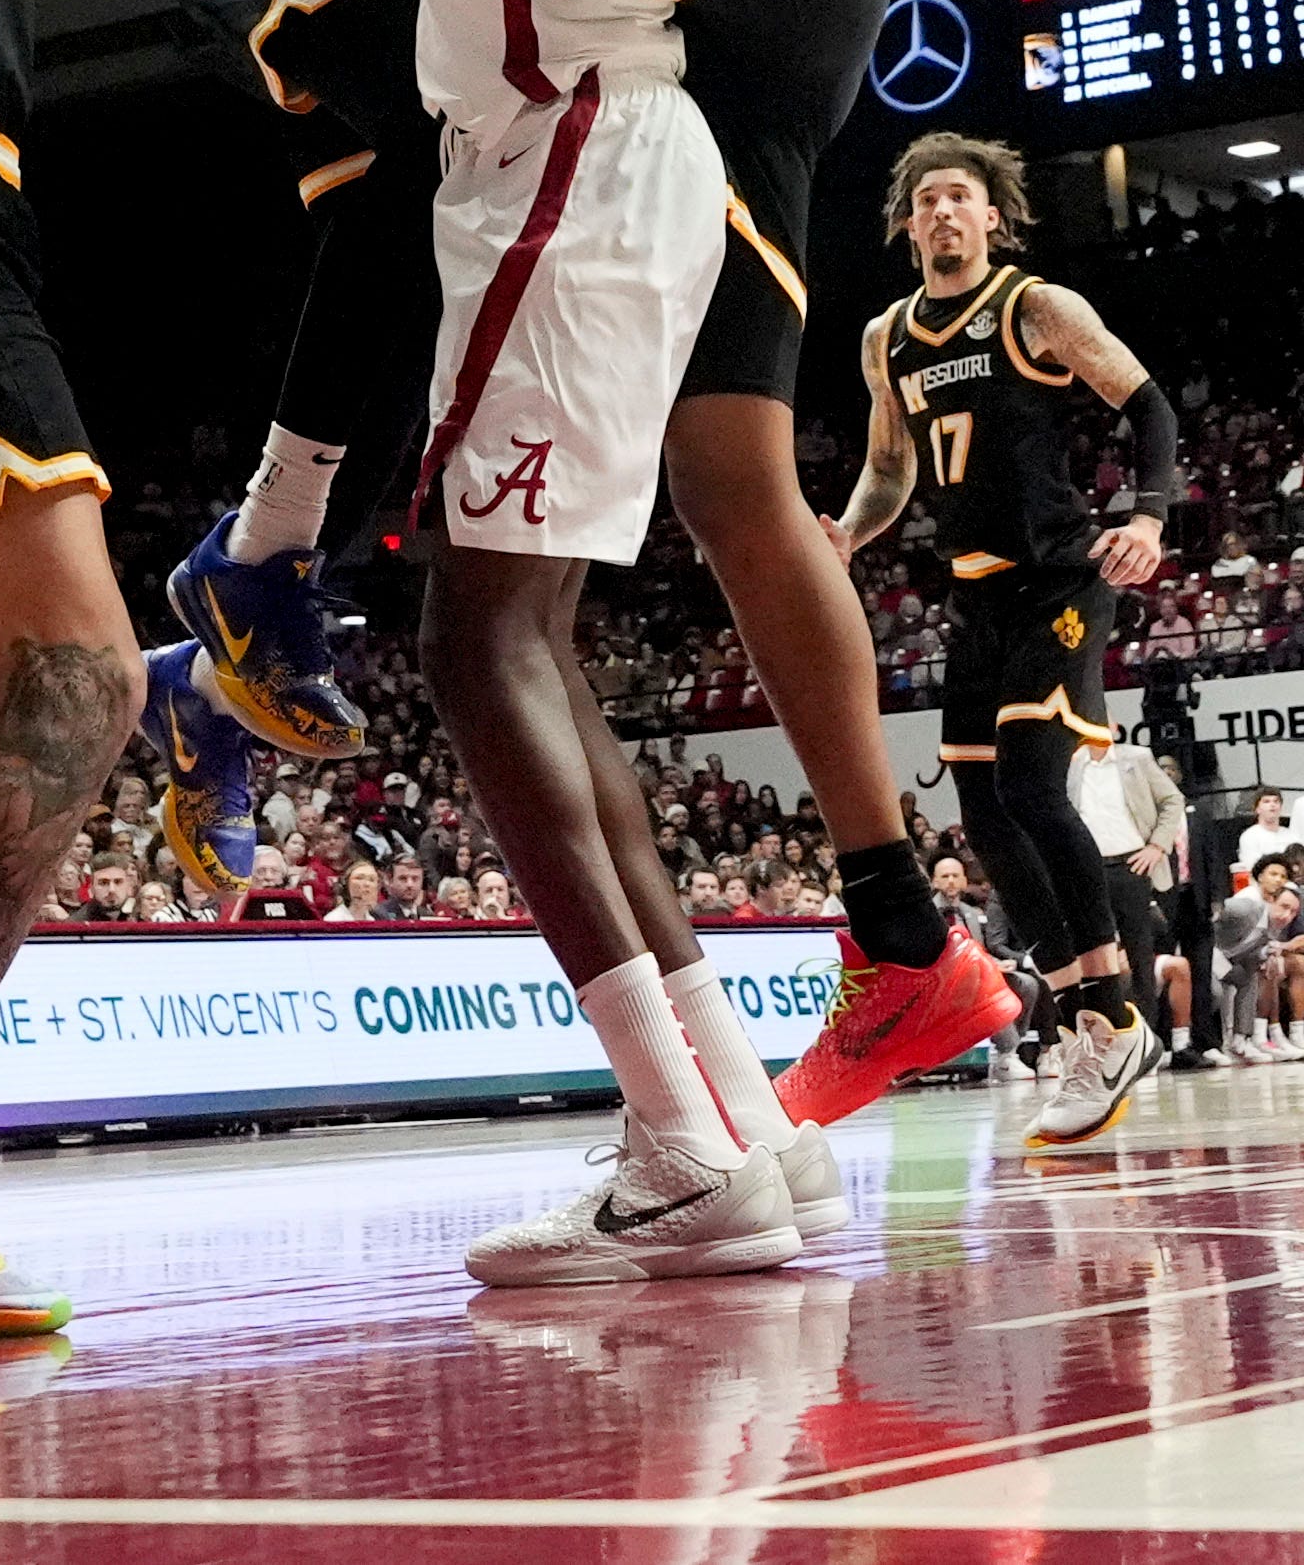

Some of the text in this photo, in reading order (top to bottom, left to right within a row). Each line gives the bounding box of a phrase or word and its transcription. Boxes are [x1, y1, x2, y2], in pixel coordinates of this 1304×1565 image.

[899, 353, 993, 415] MISSOURI
[459, 434, 553, 525] A
[929, 412, 974, 487] 17
[1218, 706, 1304, 747] TIDE
[78, 996, 136, 1042] ST.
[140, 990, 338, 1038] VINCENT'S
[354, 982, 517, 1036] COMING
[519, 980, 593, 1027] TO
